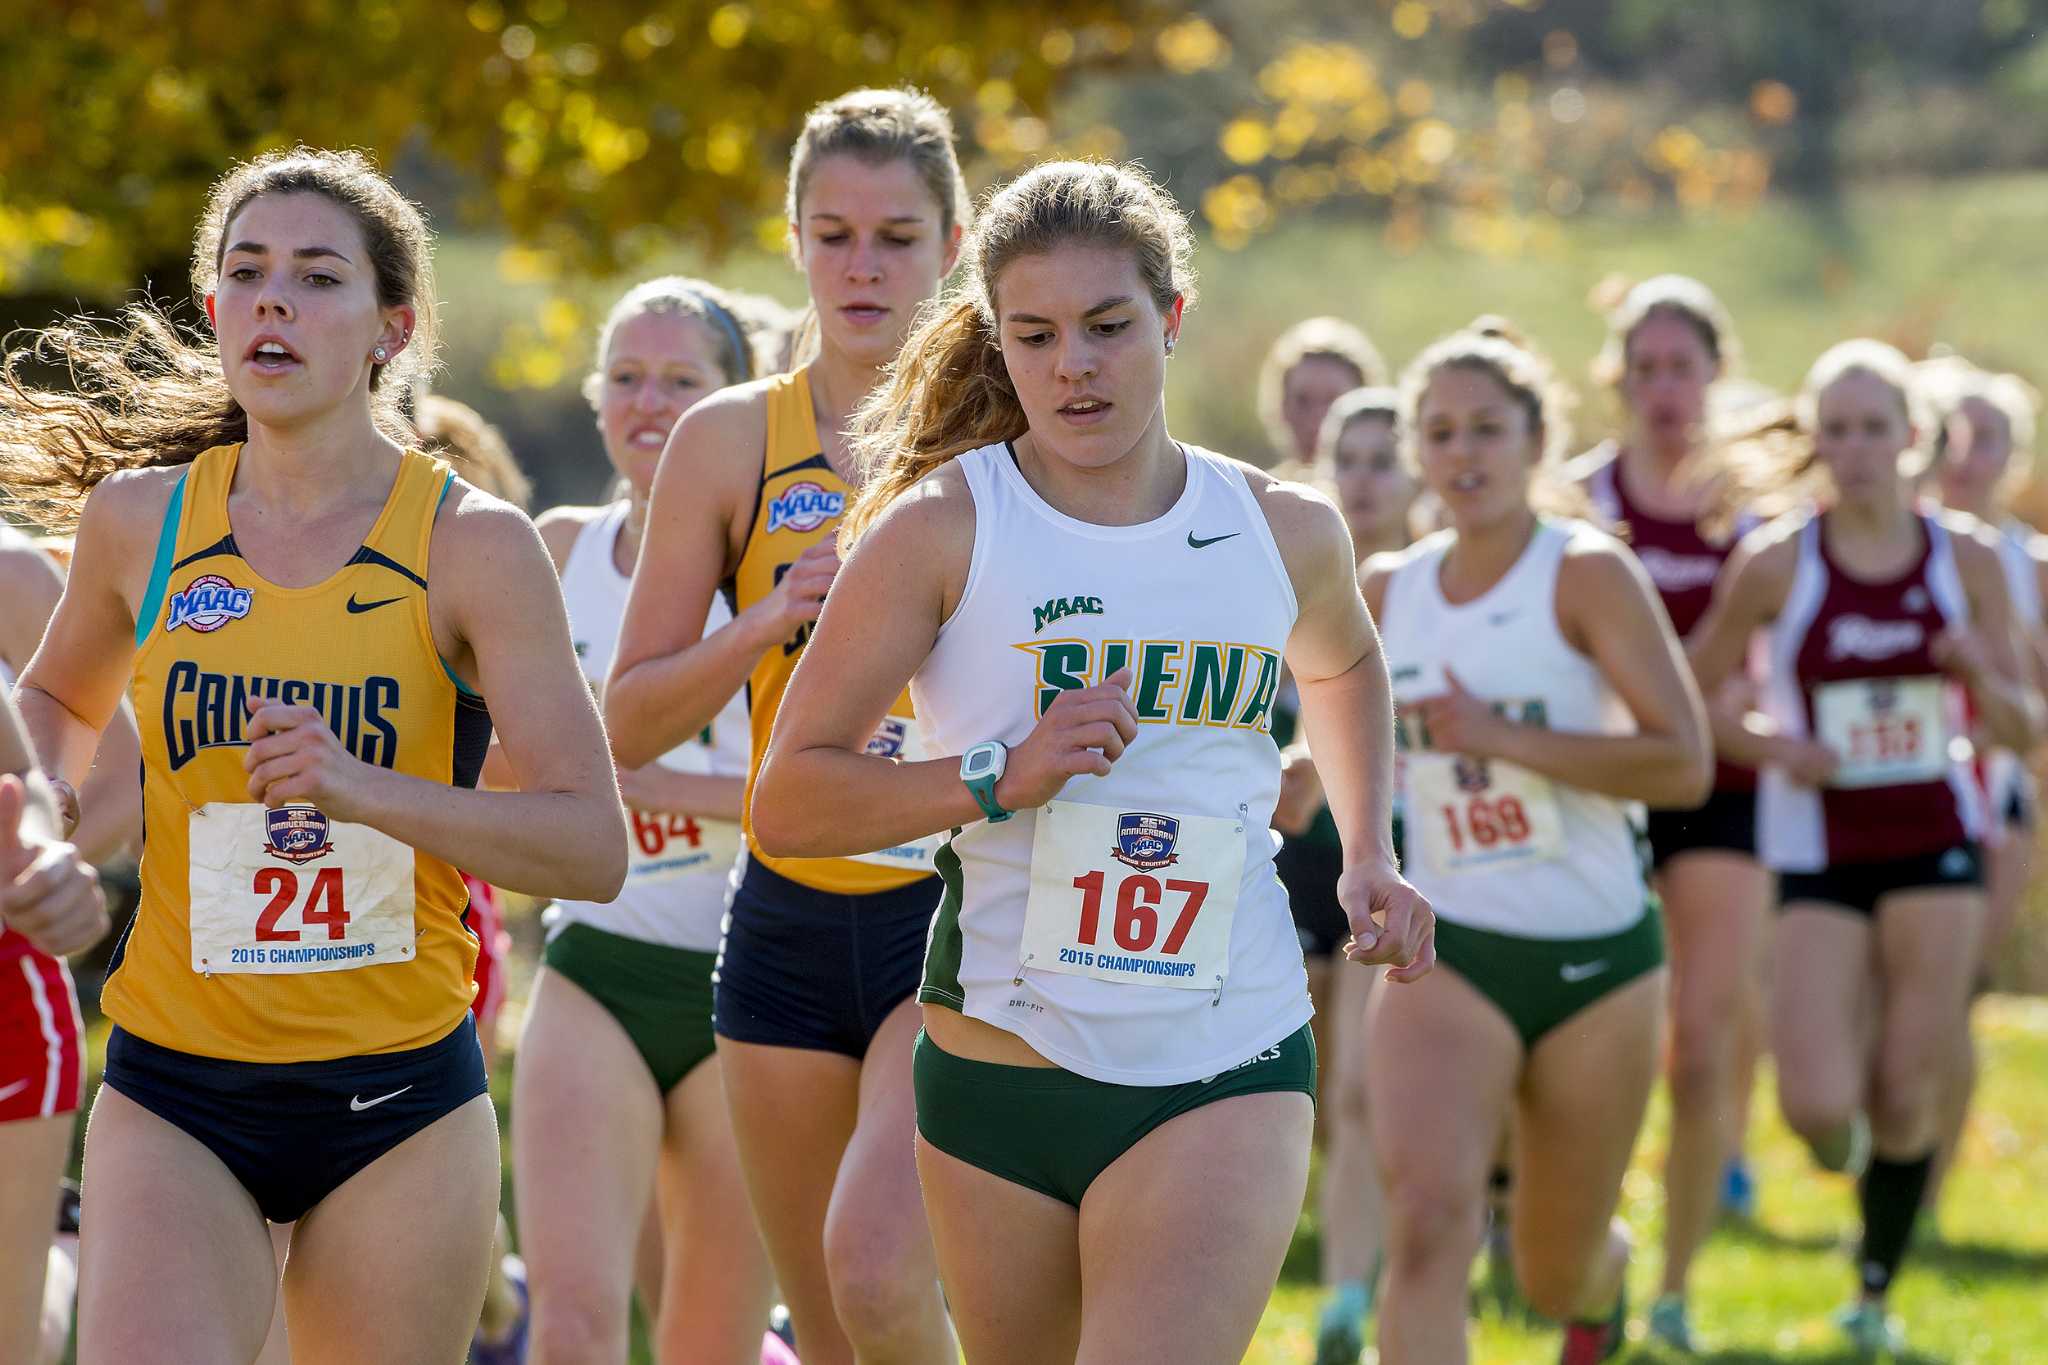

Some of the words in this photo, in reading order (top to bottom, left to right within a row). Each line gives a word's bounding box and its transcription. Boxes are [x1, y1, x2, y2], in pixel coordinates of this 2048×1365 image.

[768, 491, 846, 533] MAAC
[167, 588, 251, 631] MAAC
[1032, 596, 1104, 635] MAAC
[163, 661, 399, 771] CANUS
[282, 831, 316, 851] MAAC
[1121, 827, 1174, 841] ANNIVERSARY
[1130, 839, 1163, 857] MAAC
[253, 867, 351, 942] 24
[1073, 870, 1209, 955] 167
[231, 948, 266, 963] 2015
[269, 943, 376, 963] CHAMPIONSHIPS
[1059, 948, 1094, 967] 2015
[1097, 954, 1196, 977] CHAMPIONSHIPS
